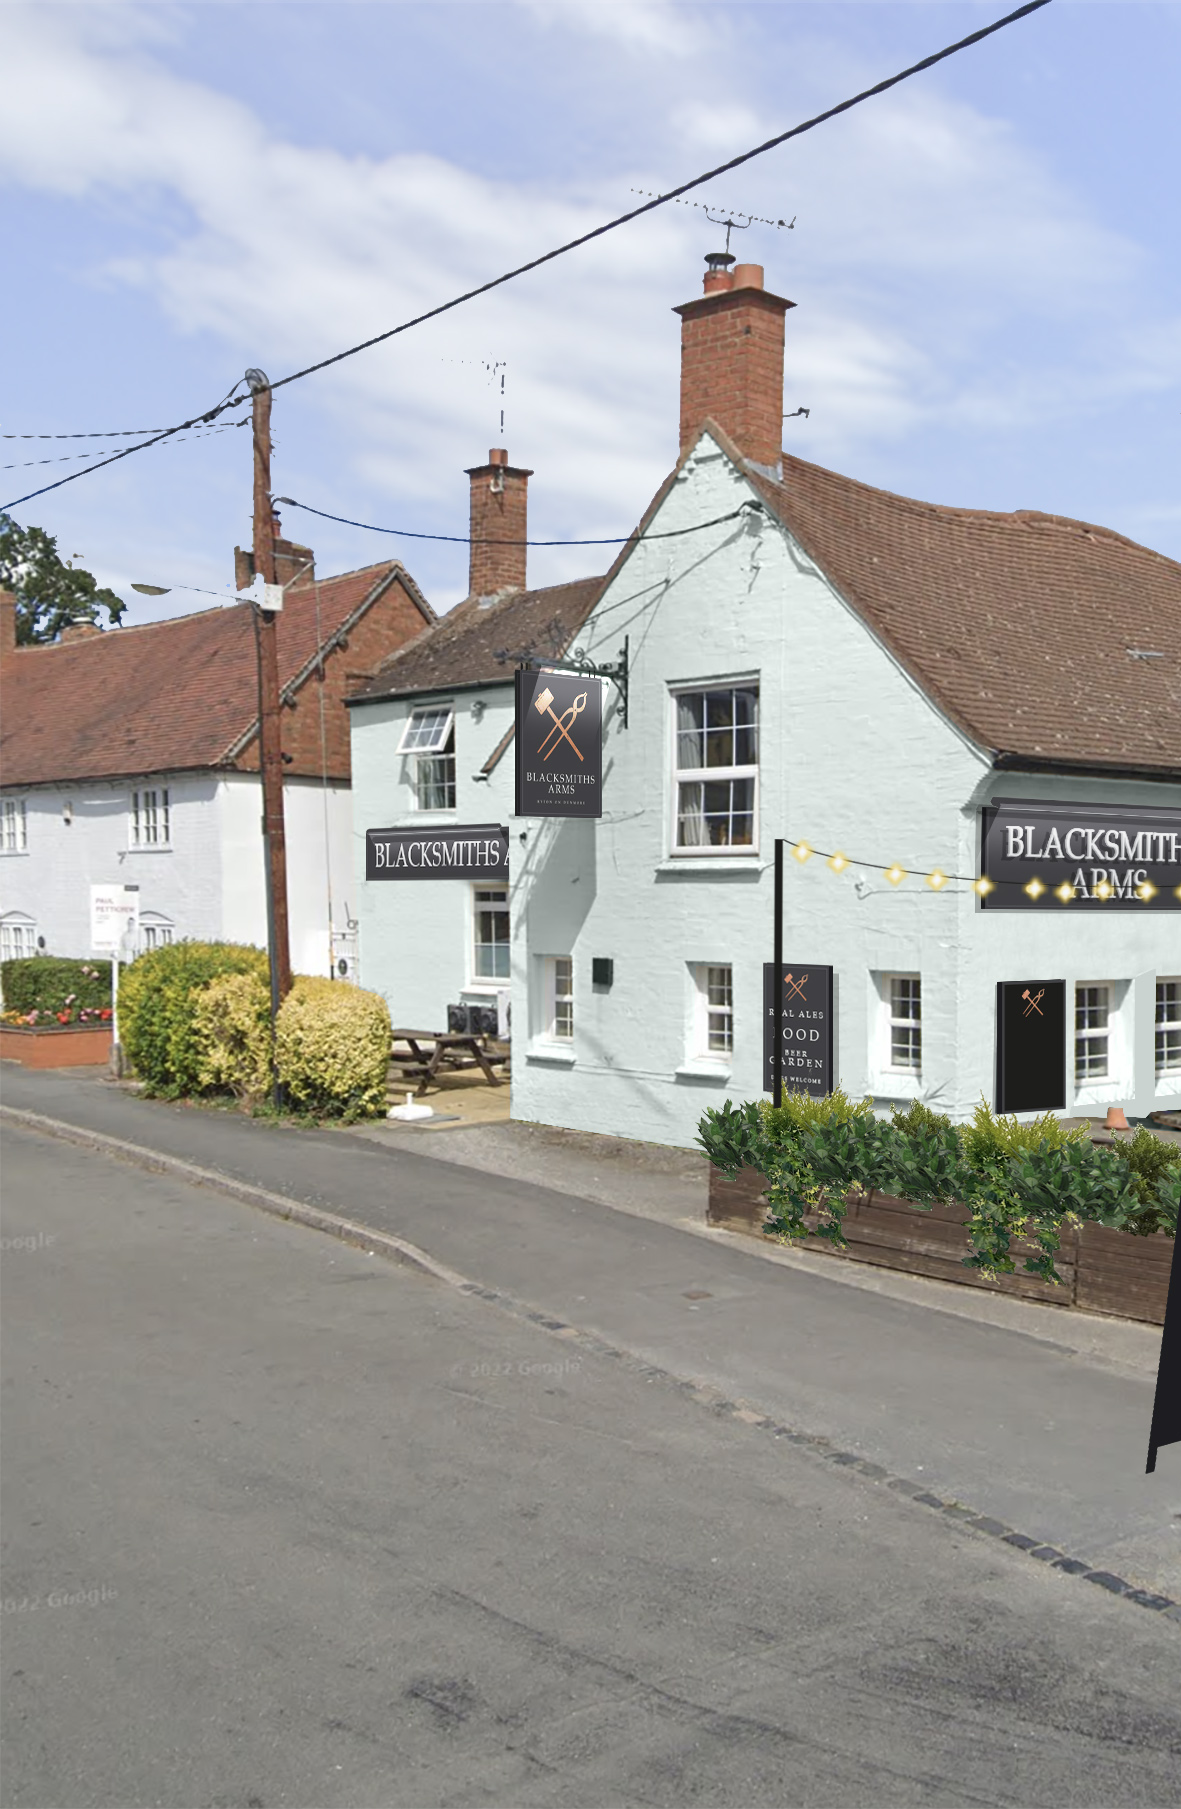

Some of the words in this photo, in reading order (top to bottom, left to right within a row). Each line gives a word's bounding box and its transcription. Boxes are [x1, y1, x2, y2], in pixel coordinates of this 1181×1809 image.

[526, 772, 596, 784] BLACKSMITHS
[548, 784, 575, 794] ARMS
[375, 840, 500, 868] BLACKSMITHS
[1071, 867, 1147, 900] ARMS
[769, 1008, 794, 1017] RAL
[798, 1010, 824, 1019] ALES
[773, 1027, 819, 1041] OOD
[784, 1049, 807, 1057] BEER
[790, 1076, 821, 1084] WELCOME
